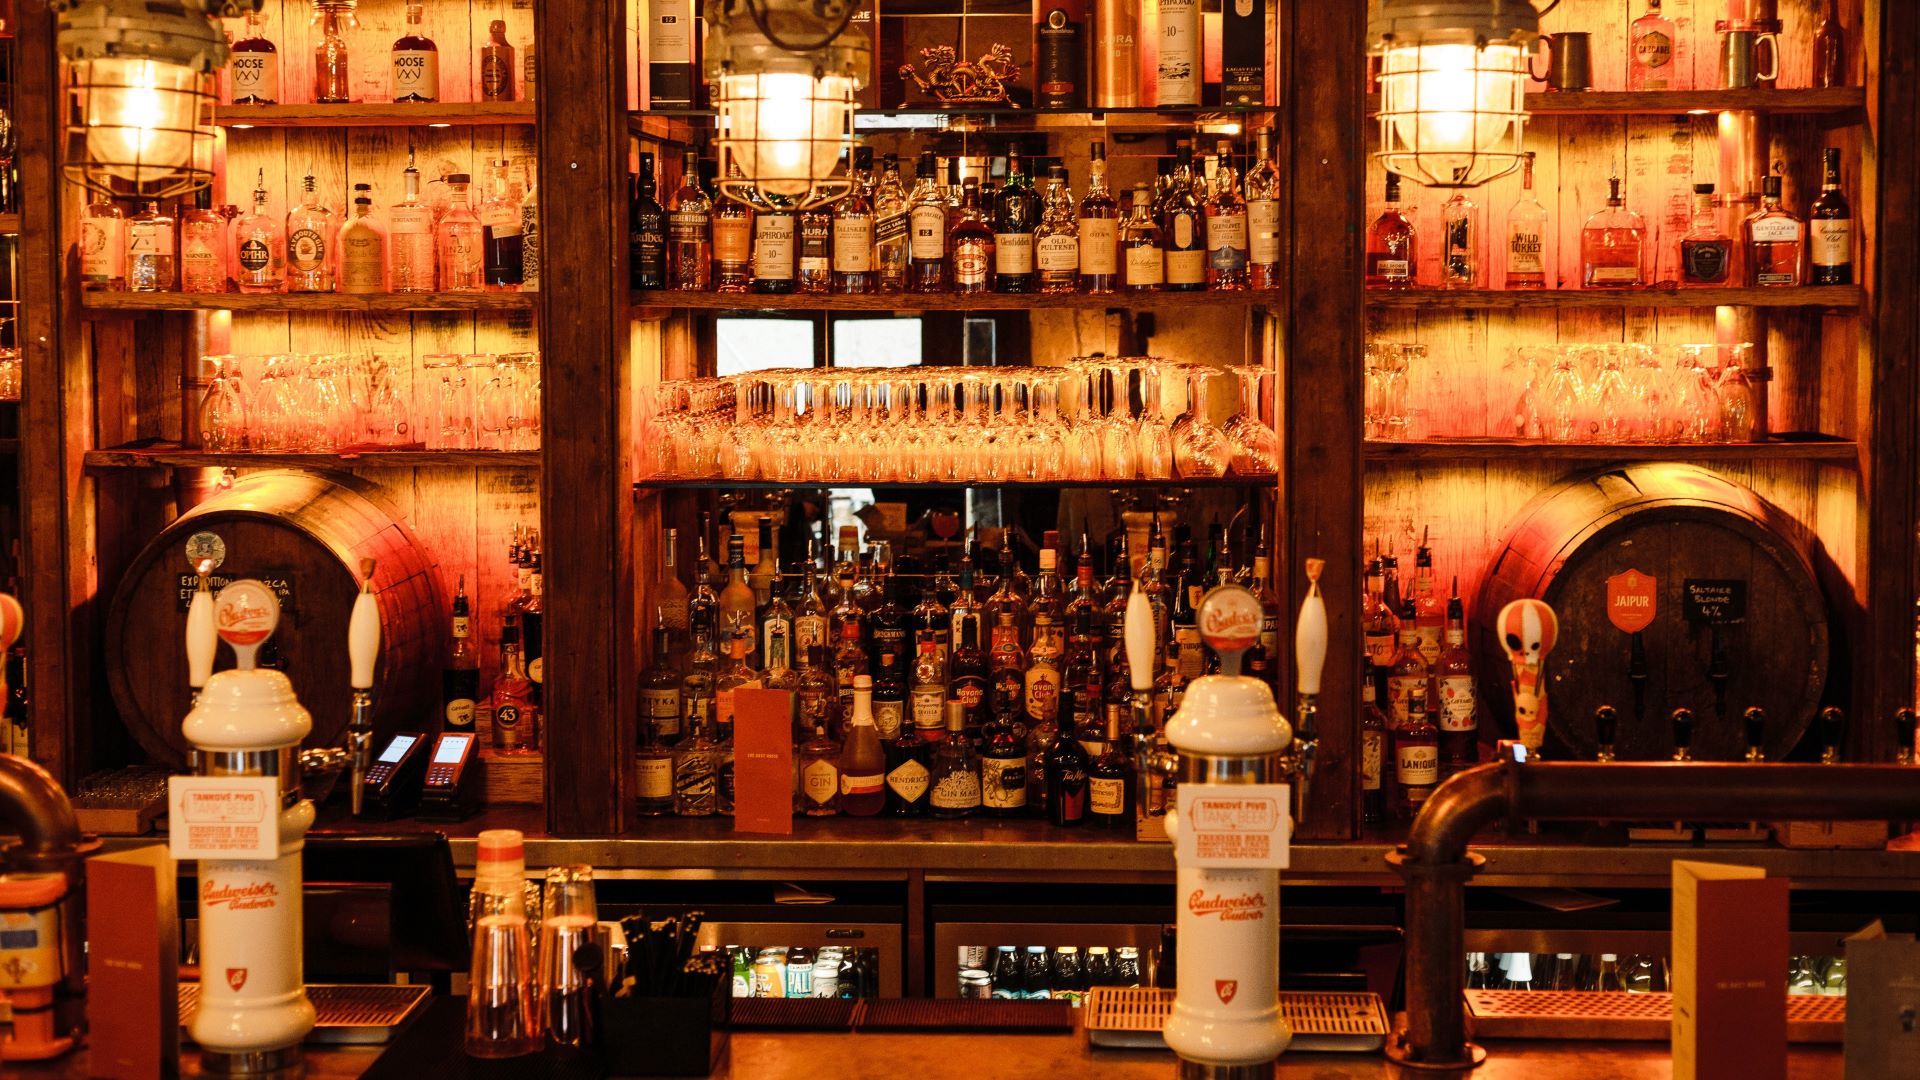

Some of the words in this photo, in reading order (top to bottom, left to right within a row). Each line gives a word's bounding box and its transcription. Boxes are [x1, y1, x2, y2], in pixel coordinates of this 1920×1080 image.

[665, 16, 676, 24] 12
[1167, 25, 1177, 37] 10
[233, 58, 264, 69] MOOSE
[394, 57, 424, 68] MOOSE
[755, 231, 794, 241] LAPHROAIG
[801, 228, 829, 236] JURA
[1516, 233, 1539, 243] WILD
[1512, 243, 1542, 253] TURKEY
[240, 250, 268, 260] OPIHR
[769, 249, 777, 260] 10
[1615, 595, 1650, 608] JAIPUR
[1702, 606, 1722, 617] 4%
[500, 708, 517, 722] 43
[1402, 759, 1437, 769] LANIQUE
[810, 777, 832, 787] GIN
[192, 793, 232, 802] TANKOVÉ
[235, 793, 255, 802] PIVO
[940, 789, 959, 798] GIN
[1202, 800, 1242, 810] TANKOVÉ
[1246, 801, 1267, 810] PIVO
[203, 880, 279, 902] Budweiser
[1188, 889, 1266, 911] Budweiser
